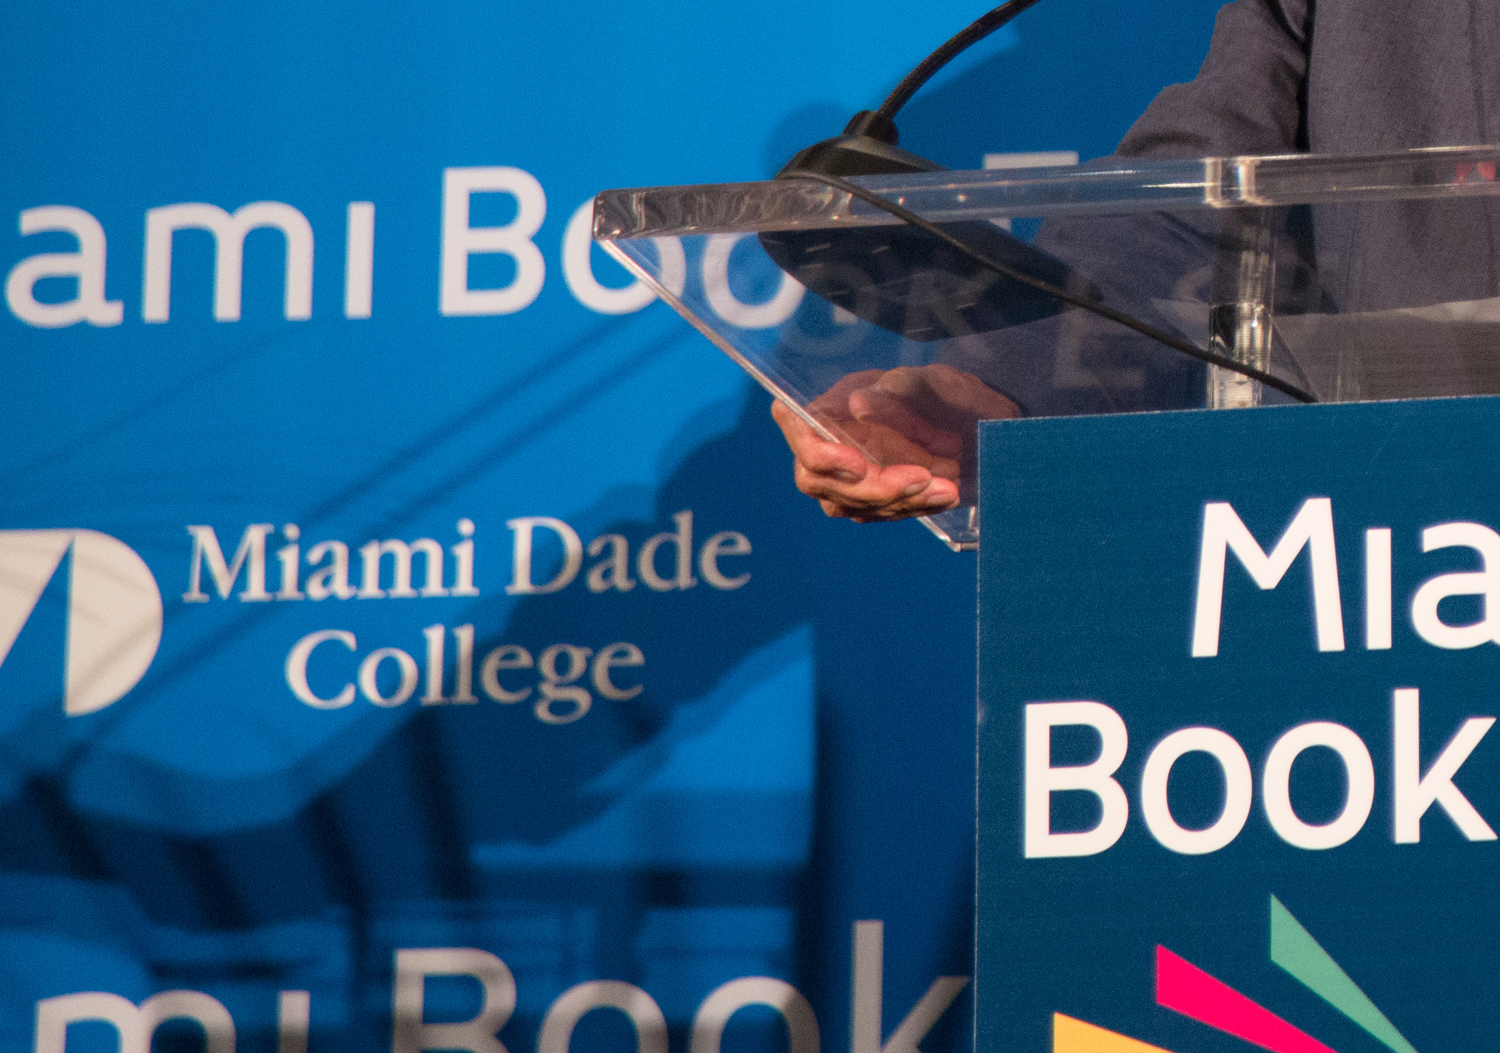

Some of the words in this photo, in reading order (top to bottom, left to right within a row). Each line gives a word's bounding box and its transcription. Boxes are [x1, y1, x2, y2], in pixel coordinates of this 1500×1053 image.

[438, 165, 856, 332] Boo
[182, 517, 481, 603] Miami
[505, 510, 754, 596] Dade
[284, 622, 647, 724] College
[1023, 686, 1500, 860] Book
